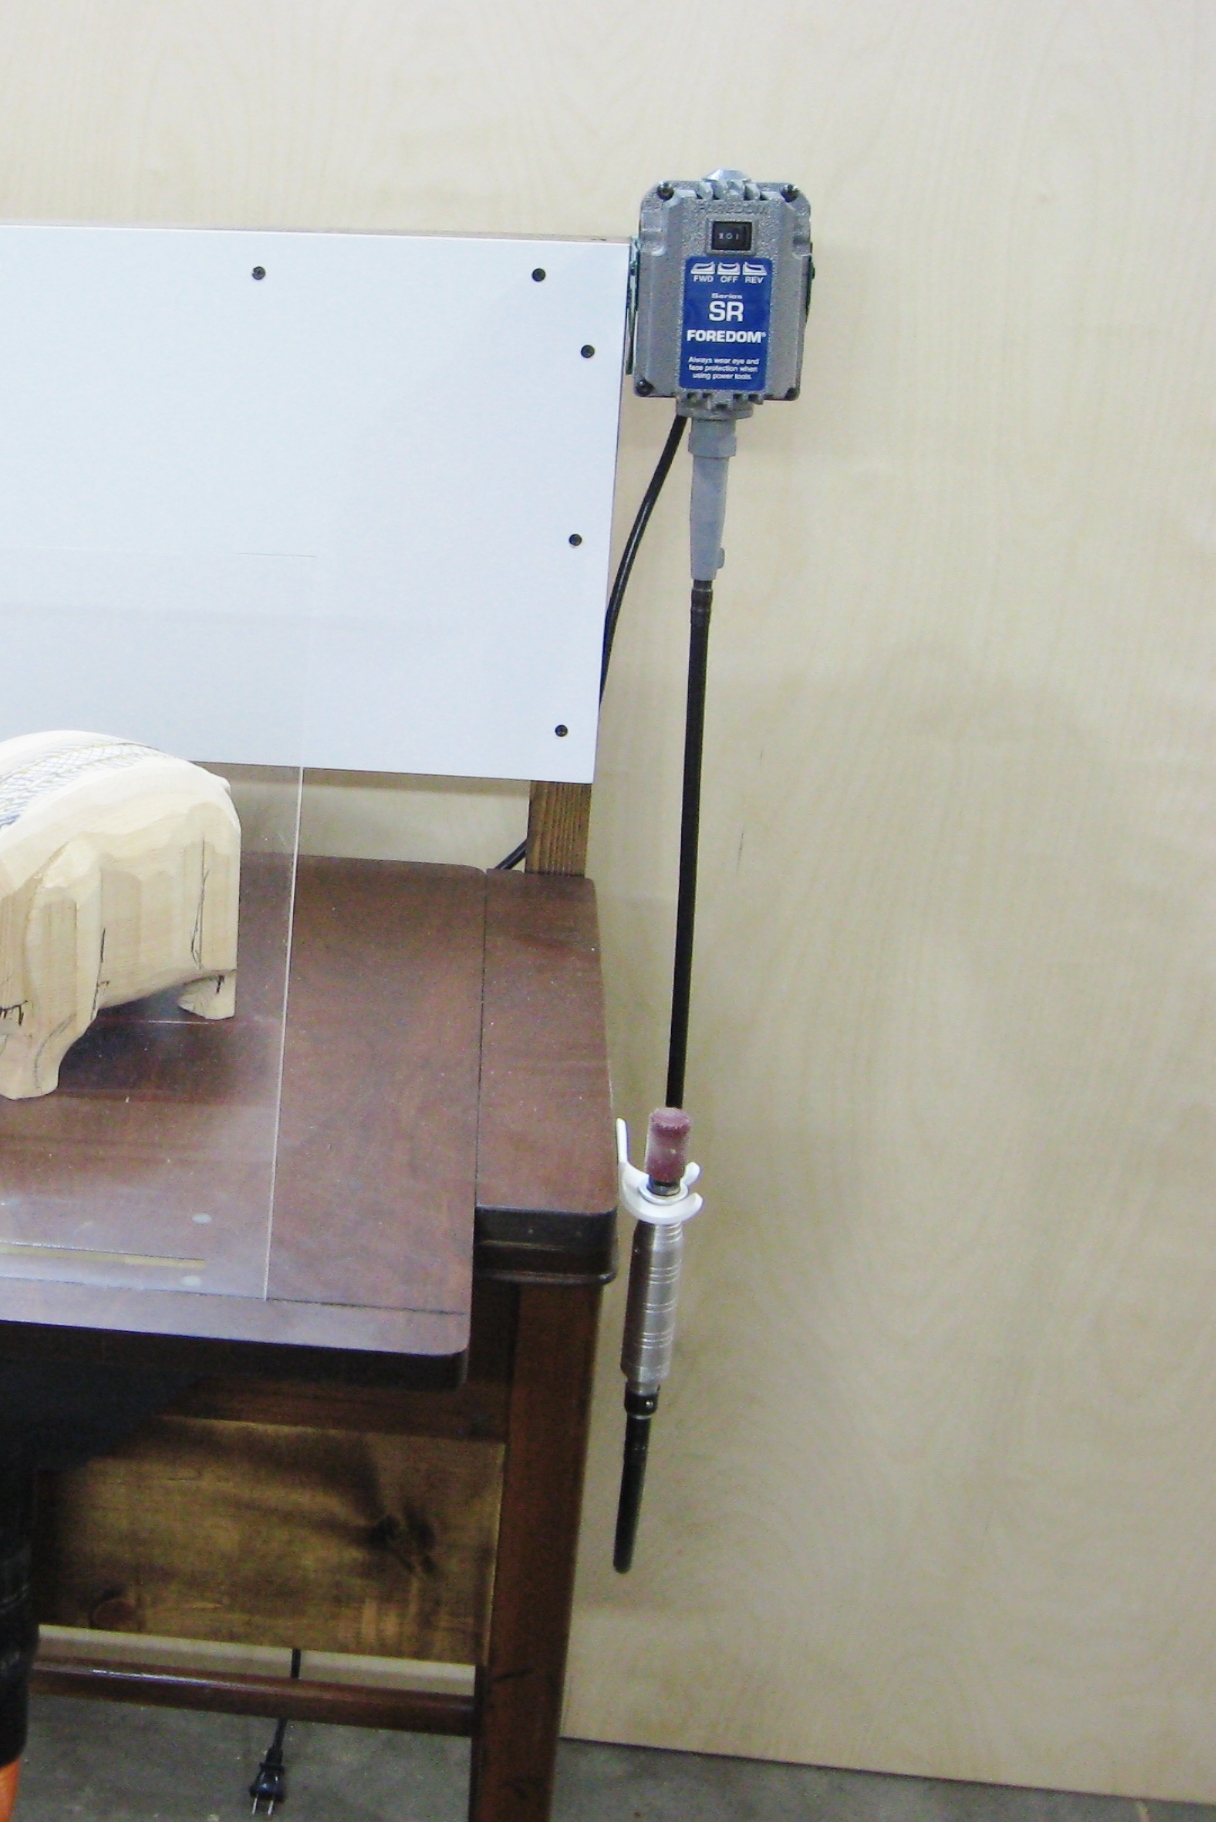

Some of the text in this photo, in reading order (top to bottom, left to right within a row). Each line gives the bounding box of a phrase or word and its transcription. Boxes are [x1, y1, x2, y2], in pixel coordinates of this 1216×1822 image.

[693, 275, 764, 284] FWD OFF REV
[711, 292, 743, 300] Series
[708, 300, 744, 322] SR
[688, 356, 713, 365] Always
[731, 358, 745, 366] eye
[692, 373, 711, 381] using
